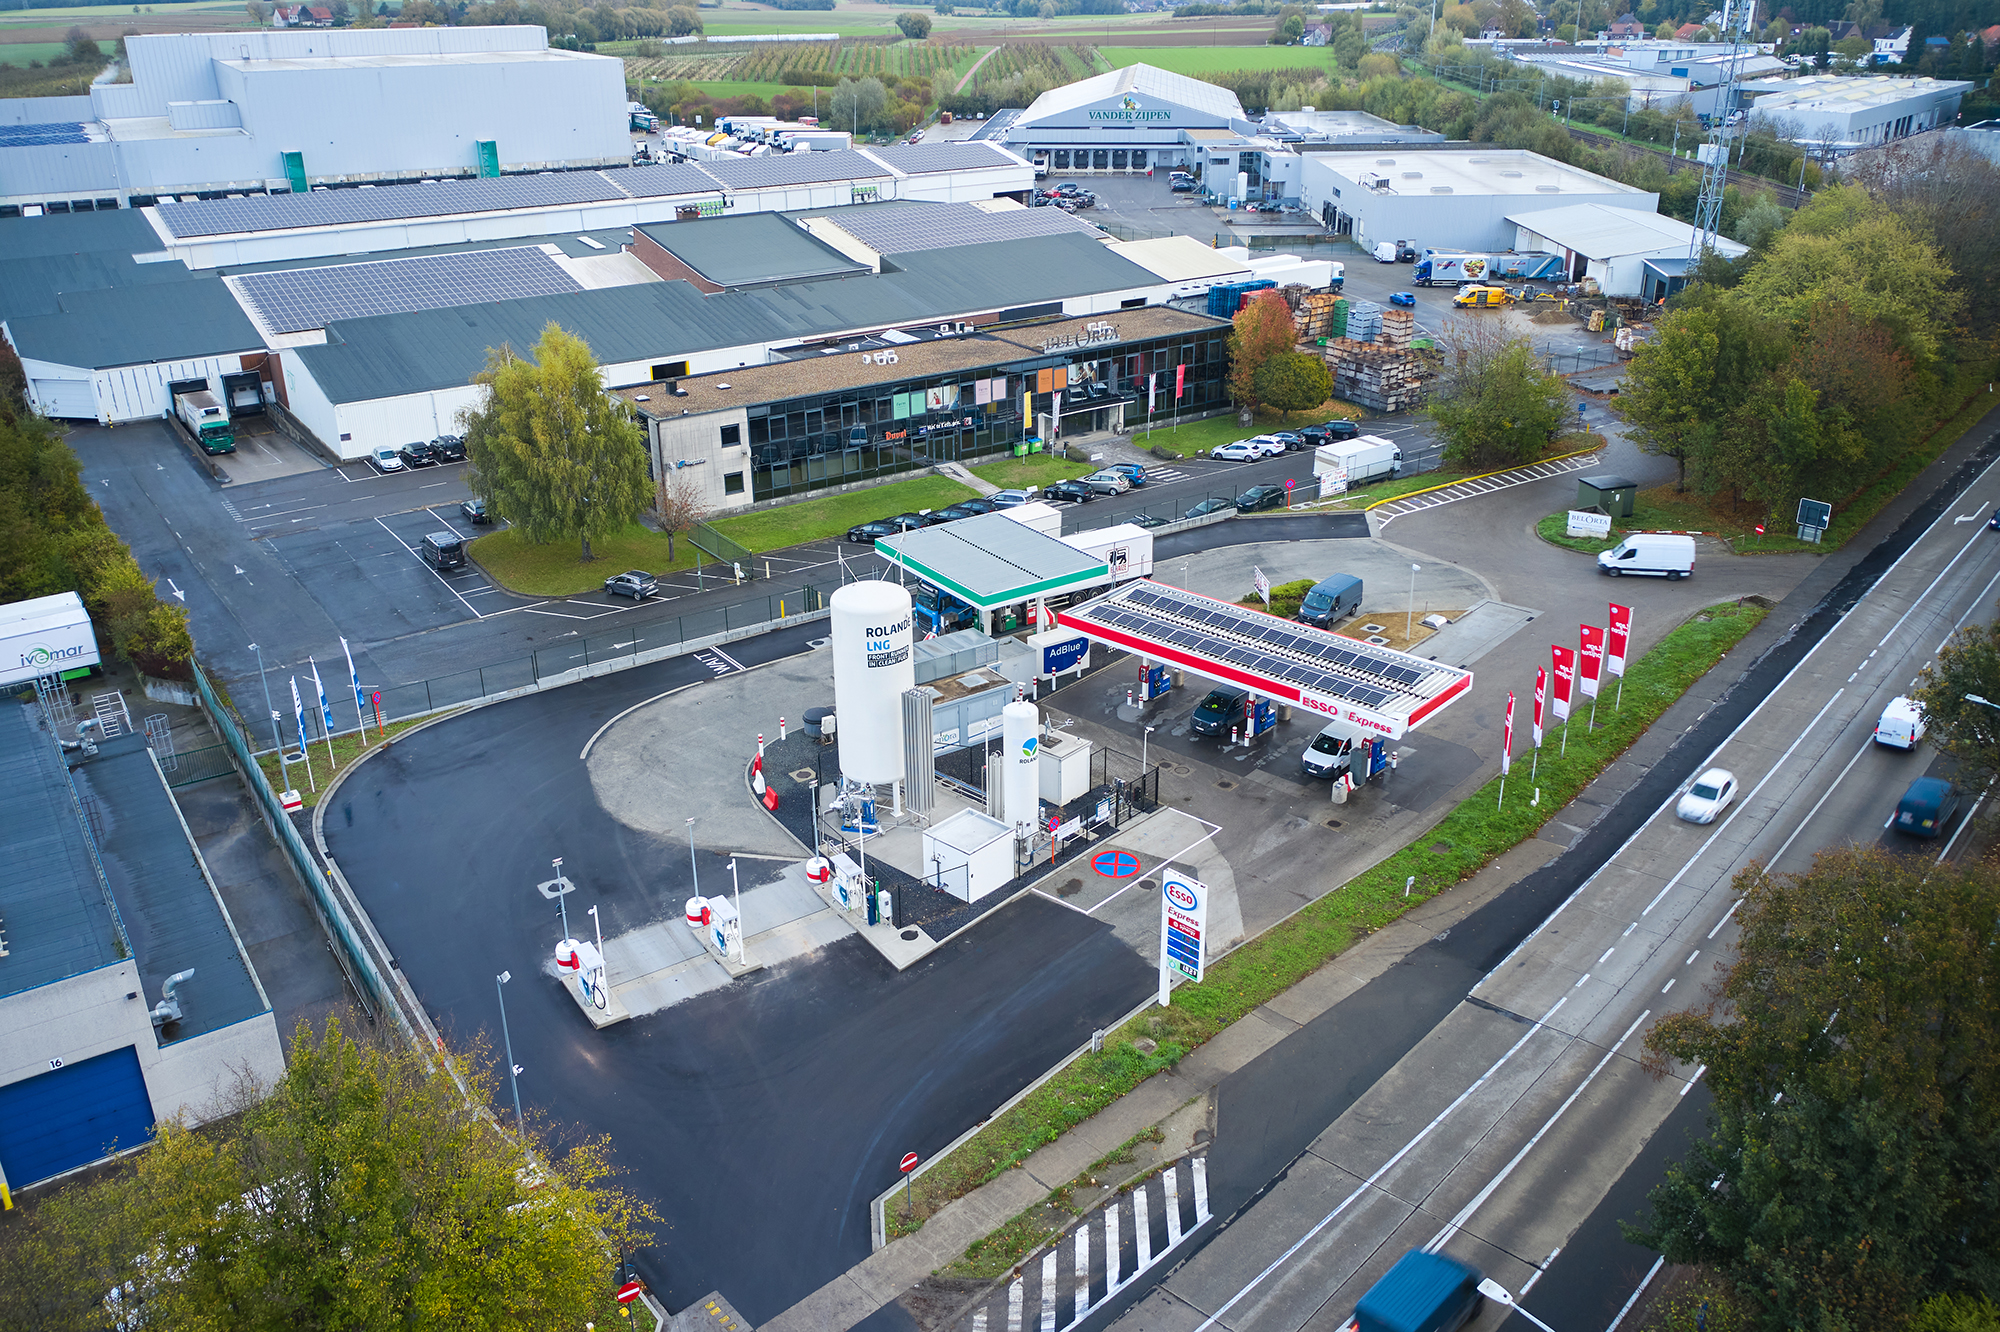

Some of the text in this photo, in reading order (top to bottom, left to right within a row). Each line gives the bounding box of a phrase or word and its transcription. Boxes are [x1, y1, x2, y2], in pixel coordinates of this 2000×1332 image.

[1089, 111, 1171, 121] VANDER ZIJPEN
[866, 617, 911, 638] ROLANDE
[20, 645, 83, 667] ivemar
[867, 640, 890, 651] LNG
[693, 653, 730, 674] WAIT
[1302, 696, 1393, 733] ESSO Express
[1168, 906, 1199, 927] Express
[50, 1059, 62, 1068] 16
